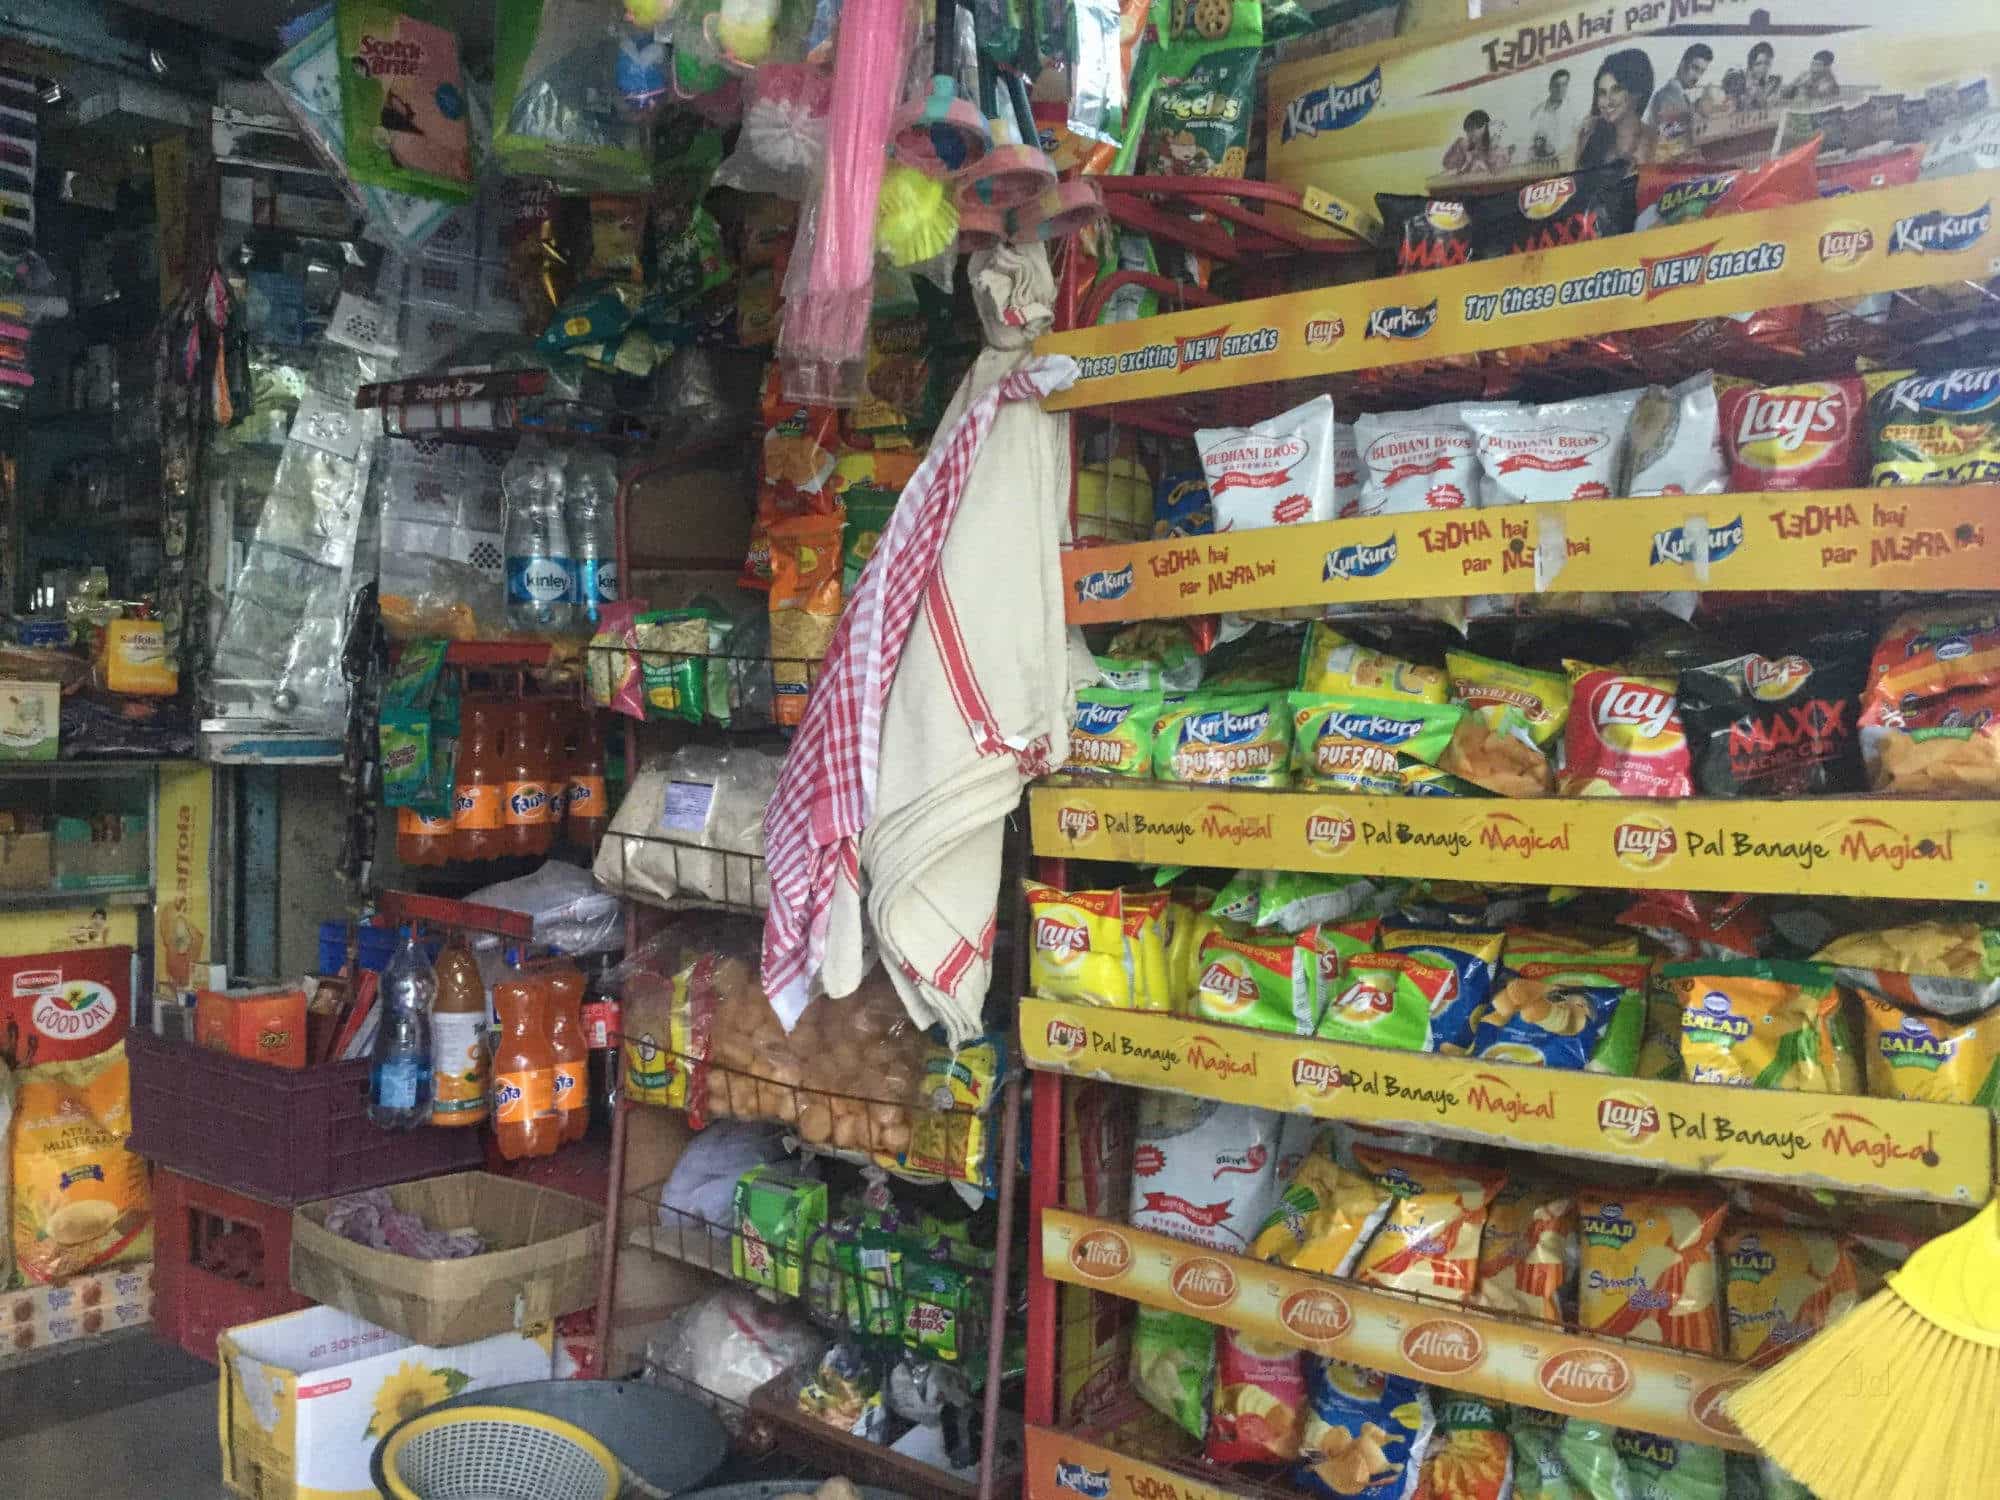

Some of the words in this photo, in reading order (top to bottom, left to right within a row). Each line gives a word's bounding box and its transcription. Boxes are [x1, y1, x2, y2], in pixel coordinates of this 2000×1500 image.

[1578, 9, 1614, 37] hai
[1624, 2, 1665, 31] par
[1286, 74, 1381, 138] Kurkure
[1893, 212, 1991, 253] Kurkure
[1464, 294, 1498, 322] Try
[1500, 285, 1554, 315] these
[1560, 267, 1645, 304] exciting
[1652, 255, 1702, 288] NEW
[1706, 242, 1786, 280] snacks
[1118, 344, 1178, 373] exciting
[1183, 335, 1217, 361] NEW
[1222, 328, 1279, 357] snacks
[1890, 366, 2000, 413] Kurkur
[1264, 443, 1298, 459] BROS
[1501, 518, 1529, 540] hai
[1873, 503, 1908, 528] hai
[1325, 542, 1397, 580] Kurkure
[1462, 556, 1492, 576] par
[1567, 536, 1591, 556] hai
[1822, 546, 1858, 568] par
[527, 574, 567, 590] kinley
[598, 574, 617, 588] kin
[1186, 710, 1271, 745] Kurkure
[1328, 711, 1422, 740] Kurkure
[1728, 698, 1847, 757] MAXX
[1105, 814, 1129, 834] Pal
[1134, 814, 1194, 845] Banaye
[1201, 814, 1272, 846] Magical
[1362, 820, 1393, 843] Pal
[1396, 822, 1472, 856] Banaye
[1480, 822, 1569, 857] Magical
[1687, 831, 1724, 857] Pal
[1733, 832, 1830, 871] Banaye
[37, 1005, 79, 1034] GOOD
[83, 999, 111, 1029] DAY
[1682, 1011, 1749, 1036] BALAJI
[1092, 1031, 1116, 1053] Pal
[1120, 1036, 1180, 1071] Banaye
[1188, 1047, 1258, 1080] Magical
[1350, 1071, 1379, 1096] Pal
[1385, 1075, 1459, 1113] Banaye
[1467, 1087, 1556, 1121] Magical
[1668, 1112, 1707, 1138] Pal
[1715, 1117, 1811, 1159] Banaye
[1822, 1126, 1935, 1168] Magical
[1177, 1270, 1227, 1297] Aliva
[1287, 1301, 1343, 1330] Aliva
[1408, 1331, 1470, 1362] Aliva
[1547, 1360, 1617, 1393] Aliva
